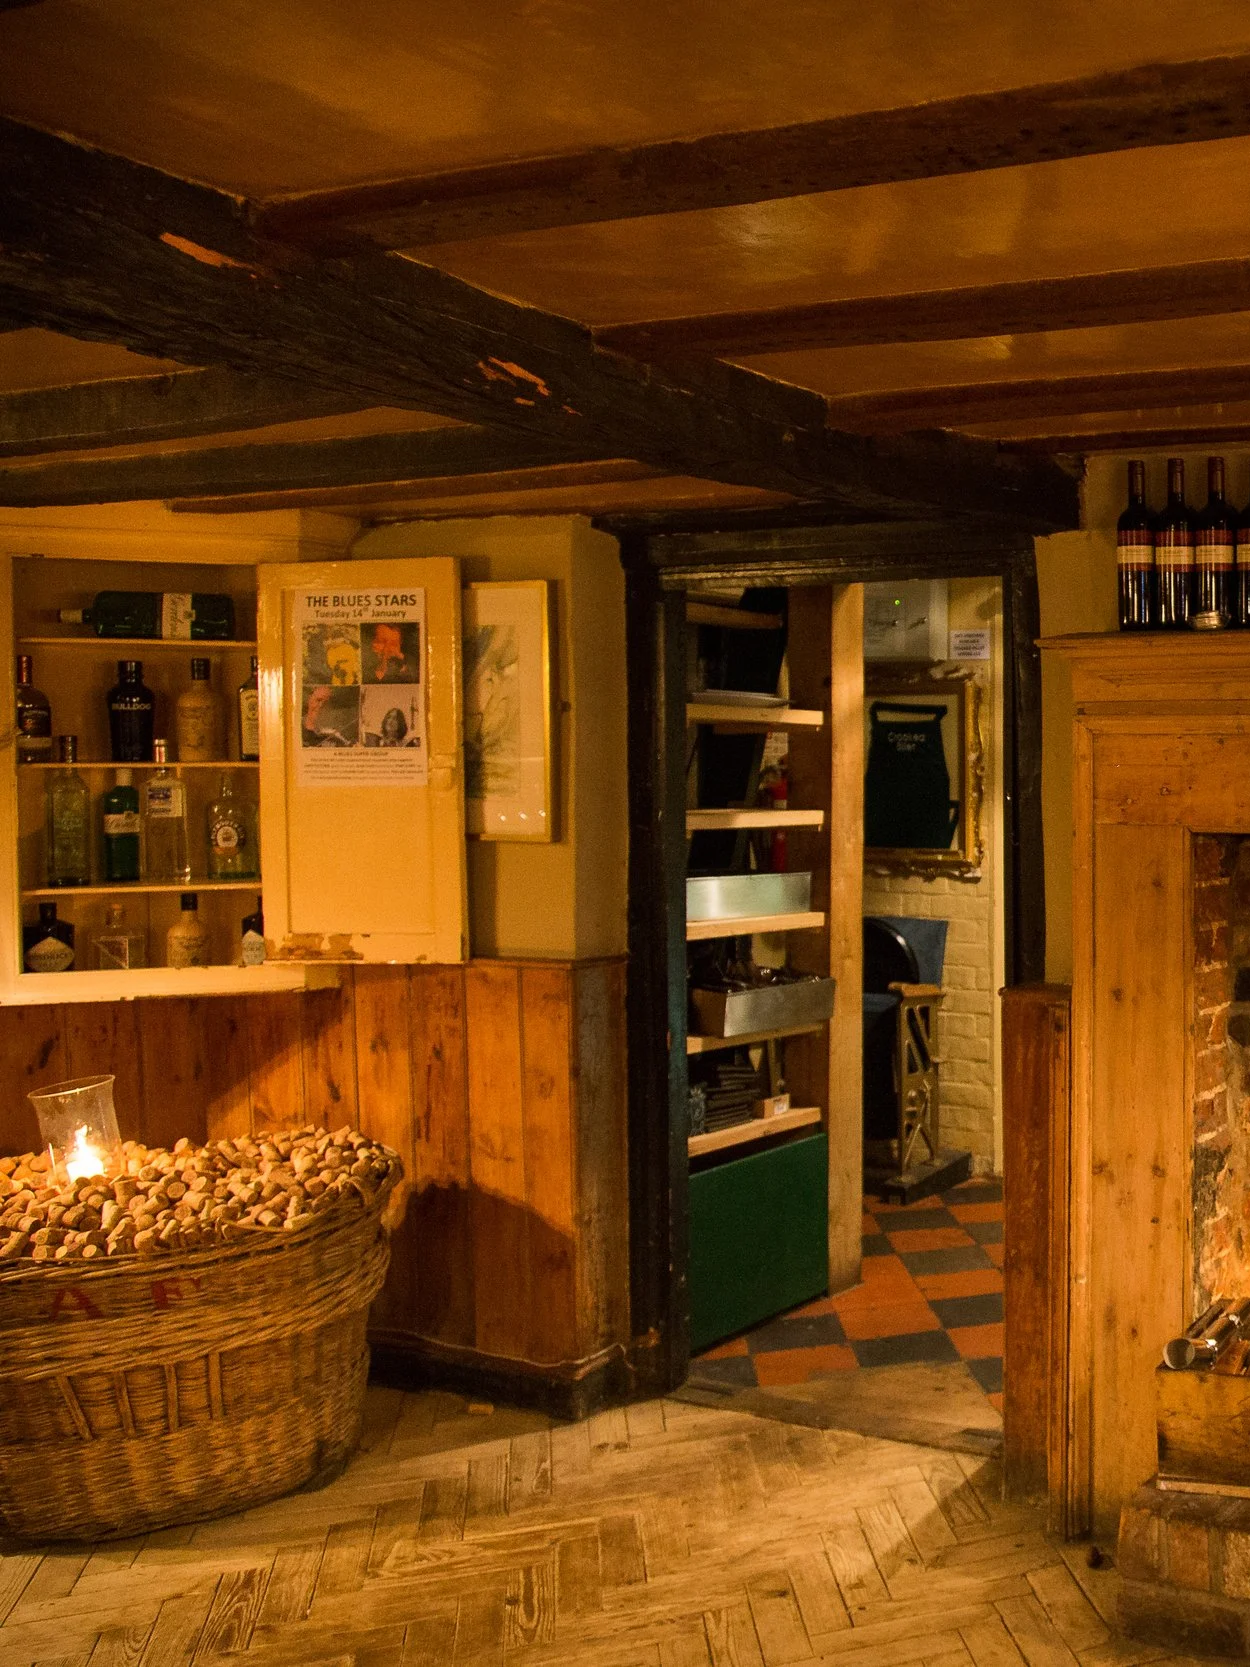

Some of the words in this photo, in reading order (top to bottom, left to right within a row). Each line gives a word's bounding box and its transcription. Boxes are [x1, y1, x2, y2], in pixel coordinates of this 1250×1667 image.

[306, 596, 329, 607] THE
[333, 595, 371, 607] BLUES
[375, 594, 417, 606] STARS
[315, 609, 350, 619] Tuesday
[372, 609, 406, 618] January
[111, 703, 151, 711] BULLDOG
